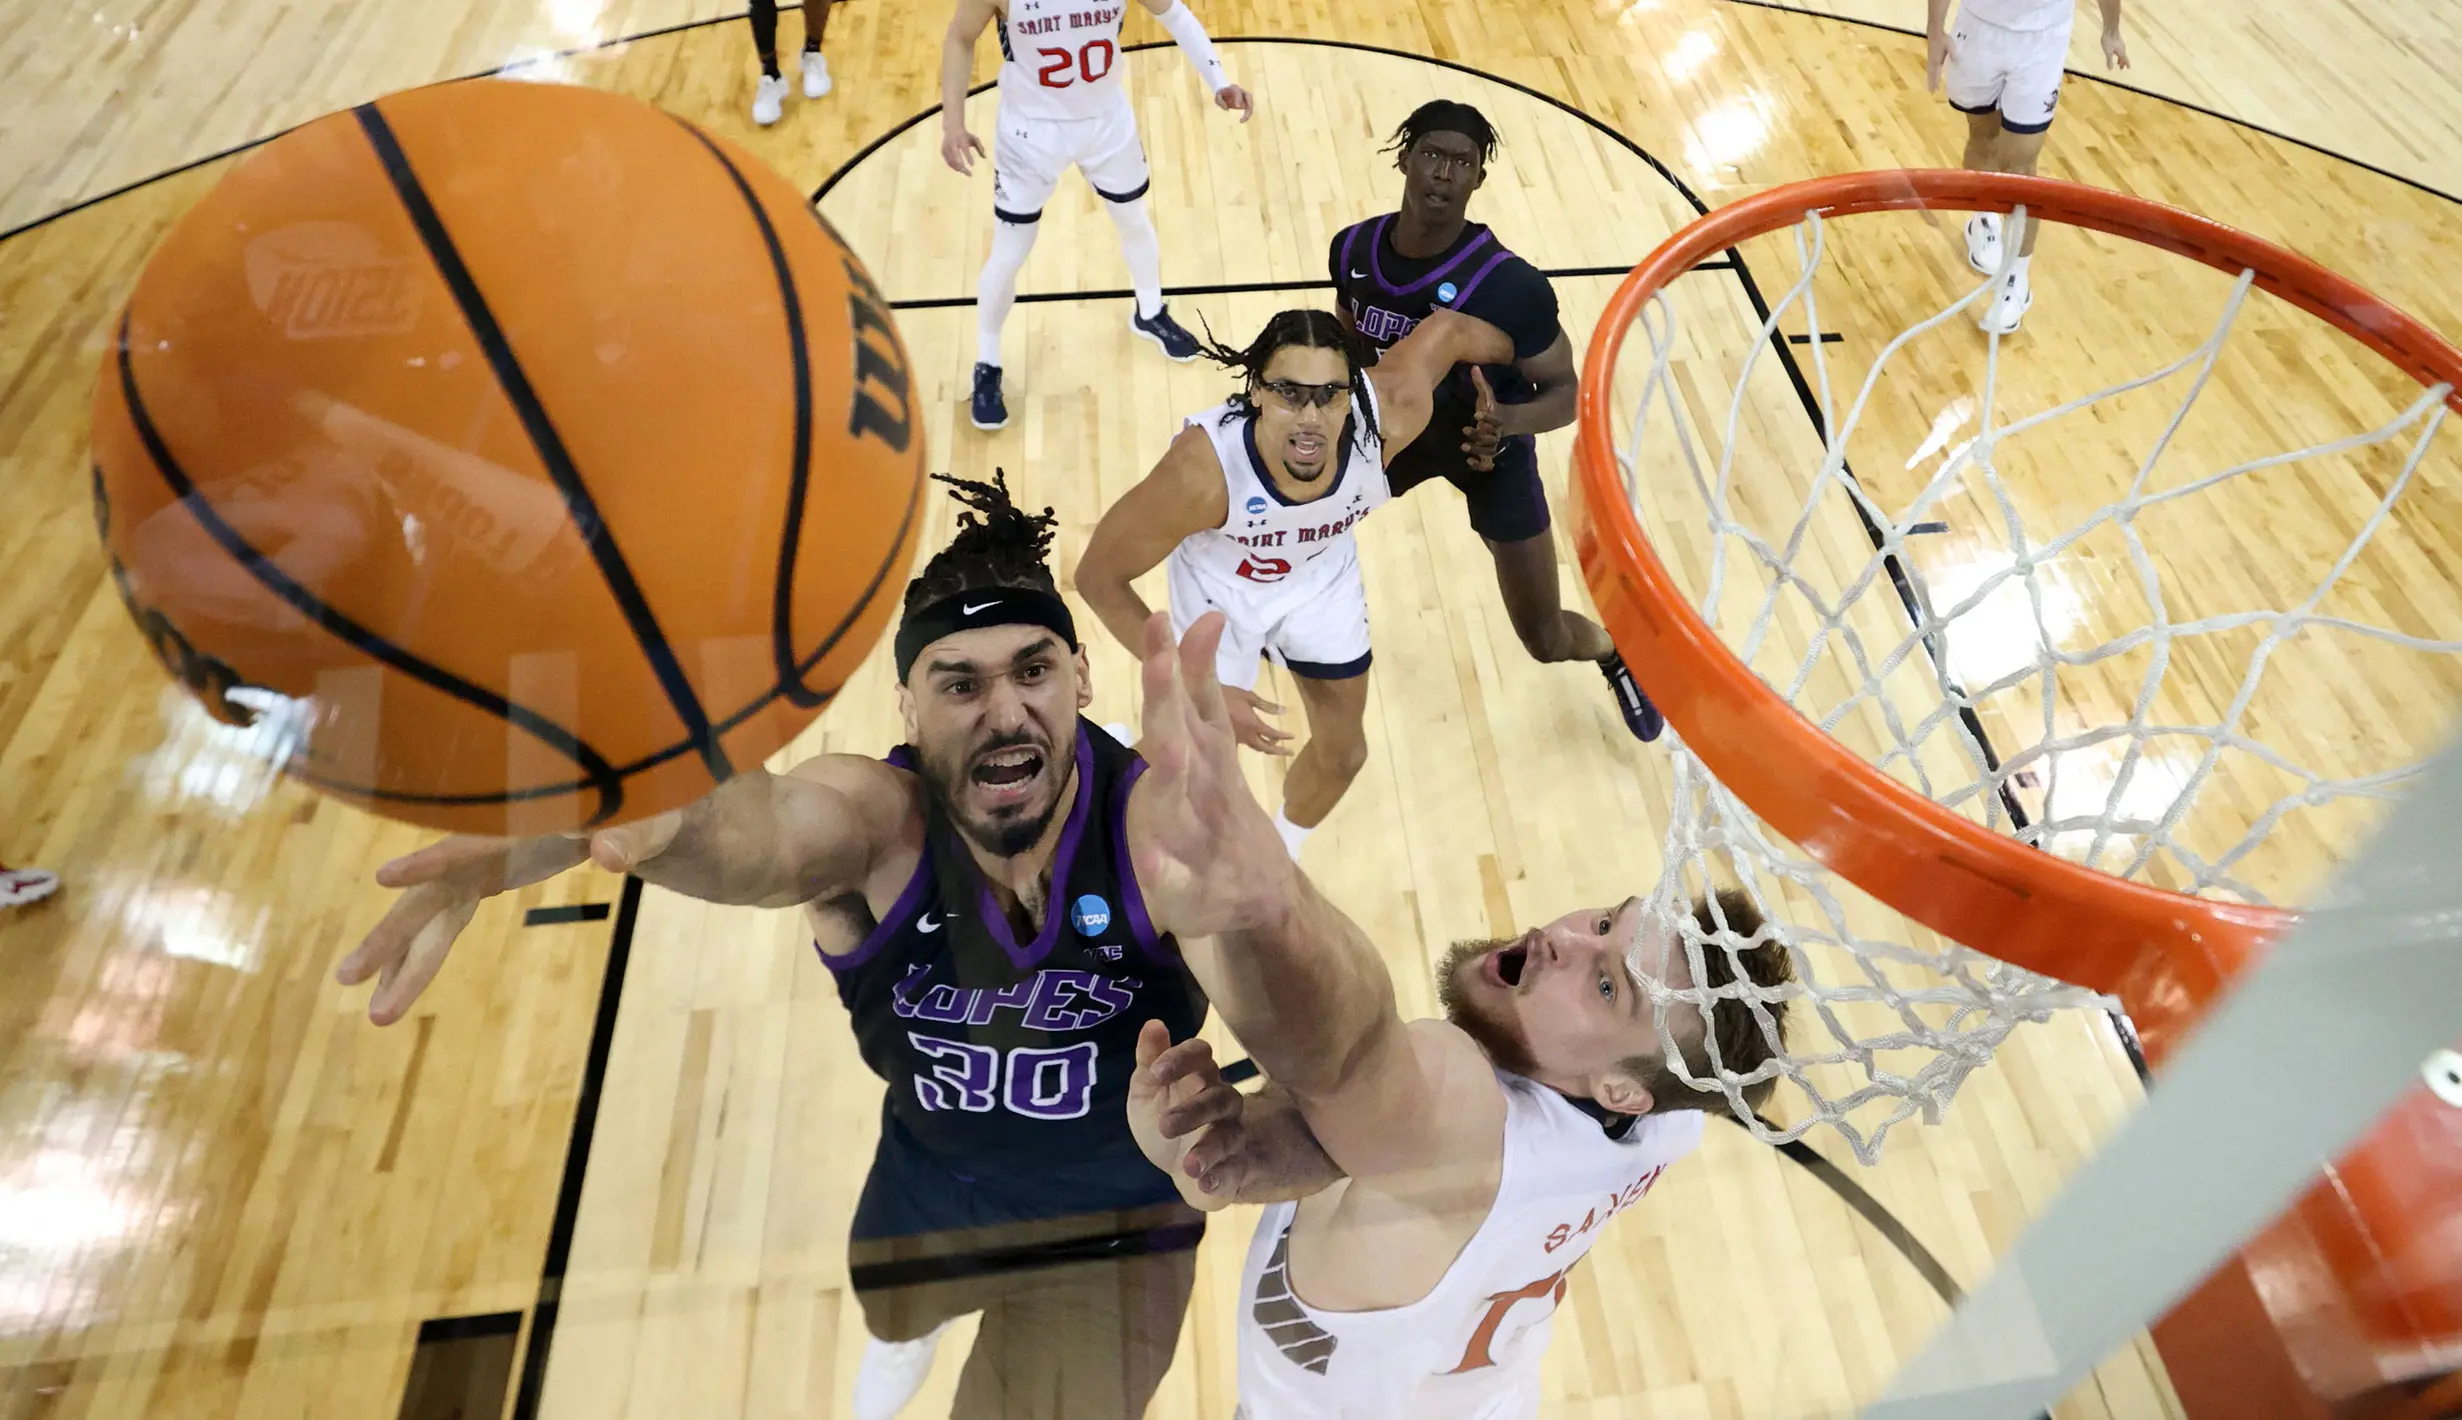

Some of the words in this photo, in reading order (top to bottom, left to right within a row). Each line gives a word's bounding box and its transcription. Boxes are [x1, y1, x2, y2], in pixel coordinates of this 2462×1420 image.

[1017, 15, 1062, 35] SAINT
[1036, 38, 1114, 88] 20
[1075, 913, 1109, 928] NCAA
[892, 963, 1144, 1031] LOPES
[907, 1030, 1099, 1121] 30
